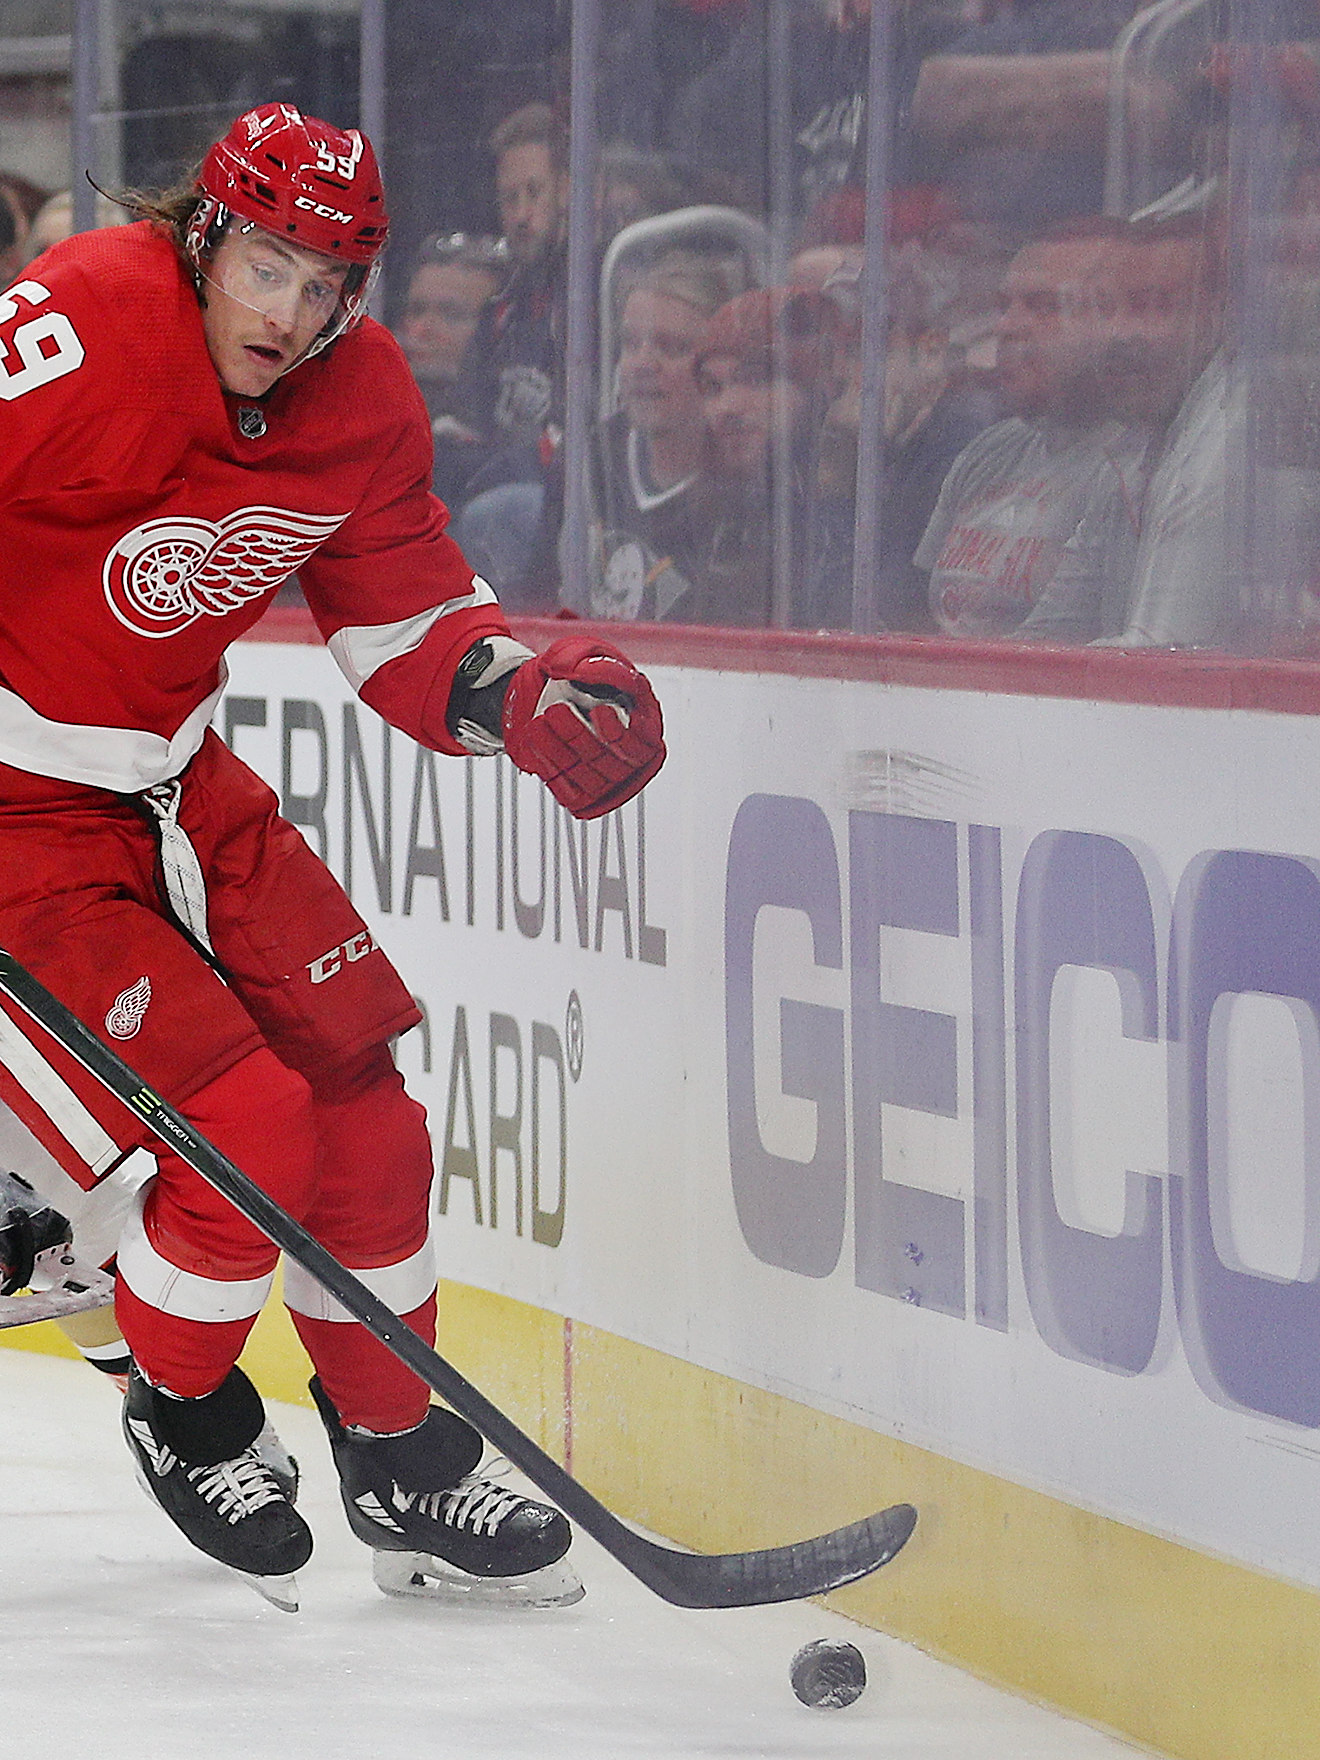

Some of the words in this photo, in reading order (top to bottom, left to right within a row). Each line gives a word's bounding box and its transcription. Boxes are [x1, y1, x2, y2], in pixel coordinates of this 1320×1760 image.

[293, 195, 354, 225] CCM
[305, 930, 380, 984] CC
[724, 790, 1320, 1430] GEICO
